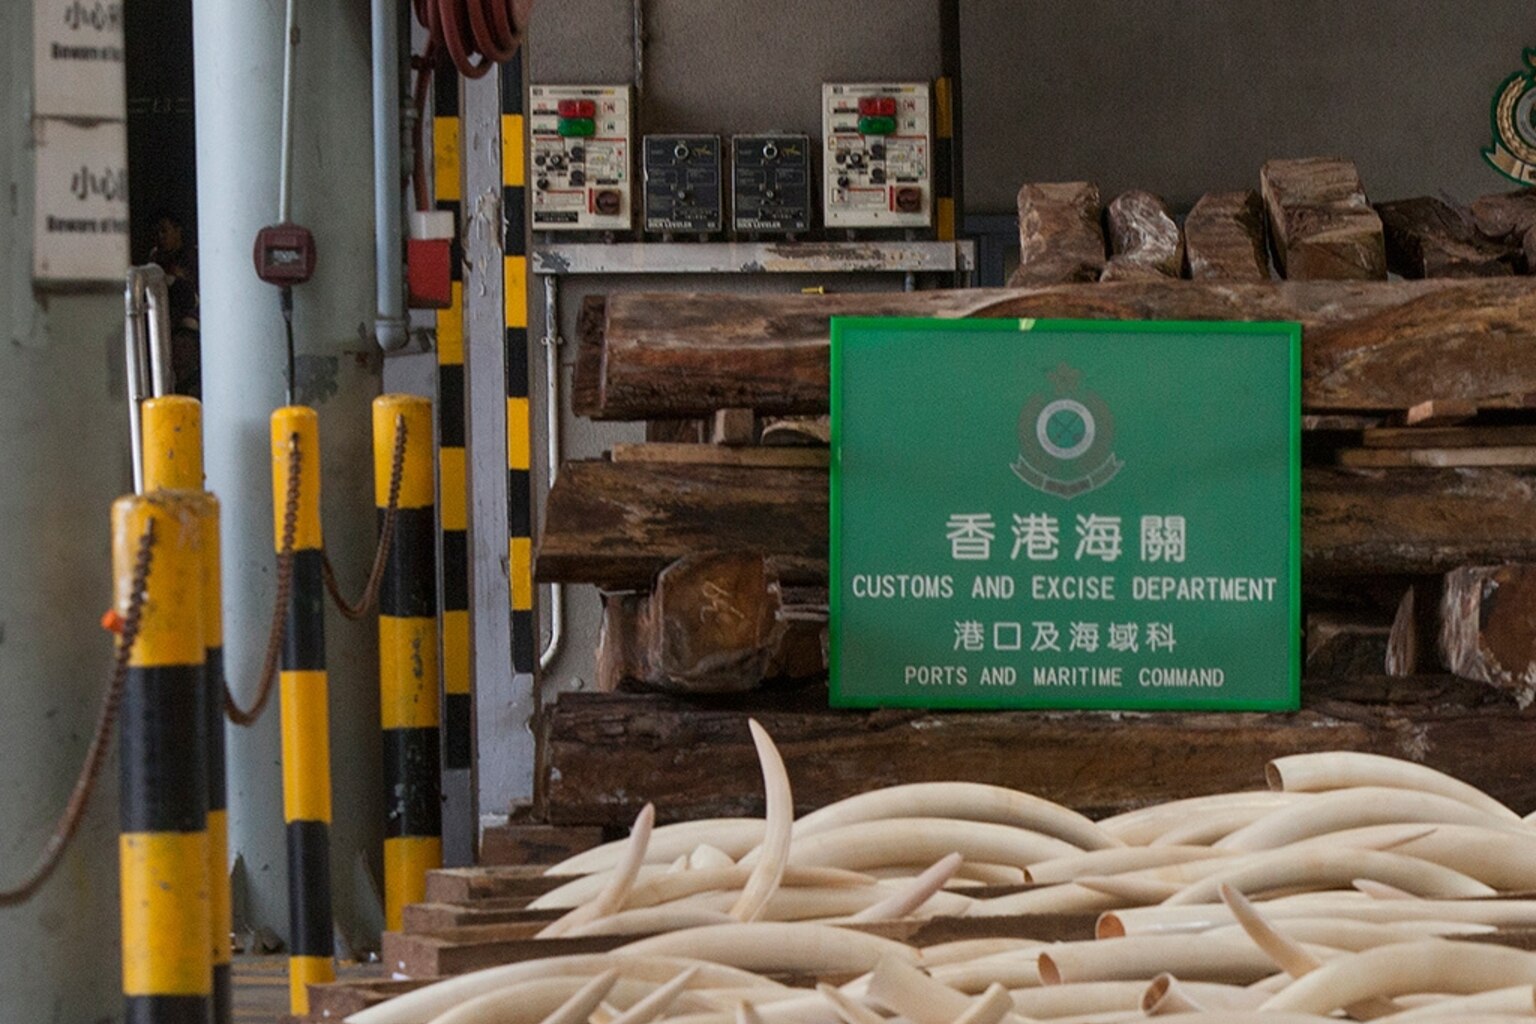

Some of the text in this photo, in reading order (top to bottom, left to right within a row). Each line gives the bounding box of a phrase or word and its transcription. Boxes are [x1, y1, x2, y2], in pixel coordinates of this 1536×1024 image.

[946, 512, 1186, 562] 香港海關
[852, 575, 1278, 602] CUSTOMS AND EXCISE DEPARTMENT
[953, 620, 1176, 653] 港口及海域科
[905, 667, 1224, 687] PORTS AND MARITIME COMMAND
